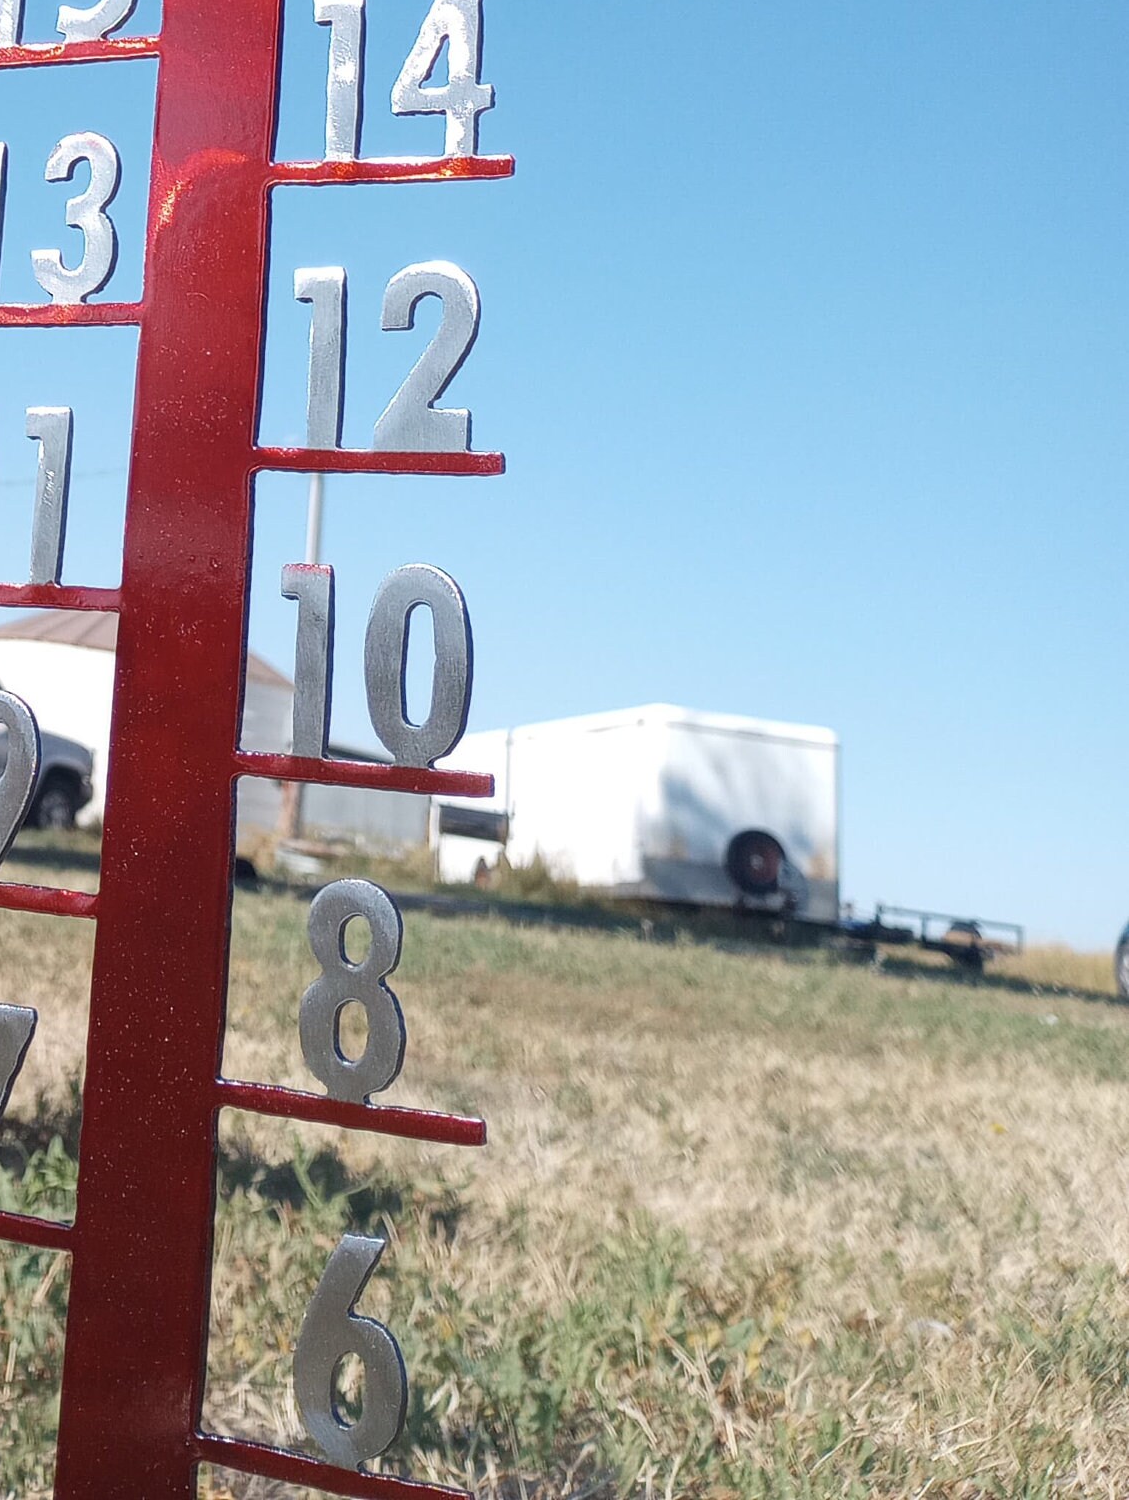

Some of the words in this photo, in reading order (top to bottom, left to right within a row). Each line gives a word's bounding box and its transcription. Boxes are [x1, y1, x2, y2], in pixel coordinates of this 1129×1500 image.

[293, 260, 481, 452] 12
[281, 563, 473, 768] 10
[299, 878, 407, 1103] 8
[293, 1232, 408, 1469] 6
